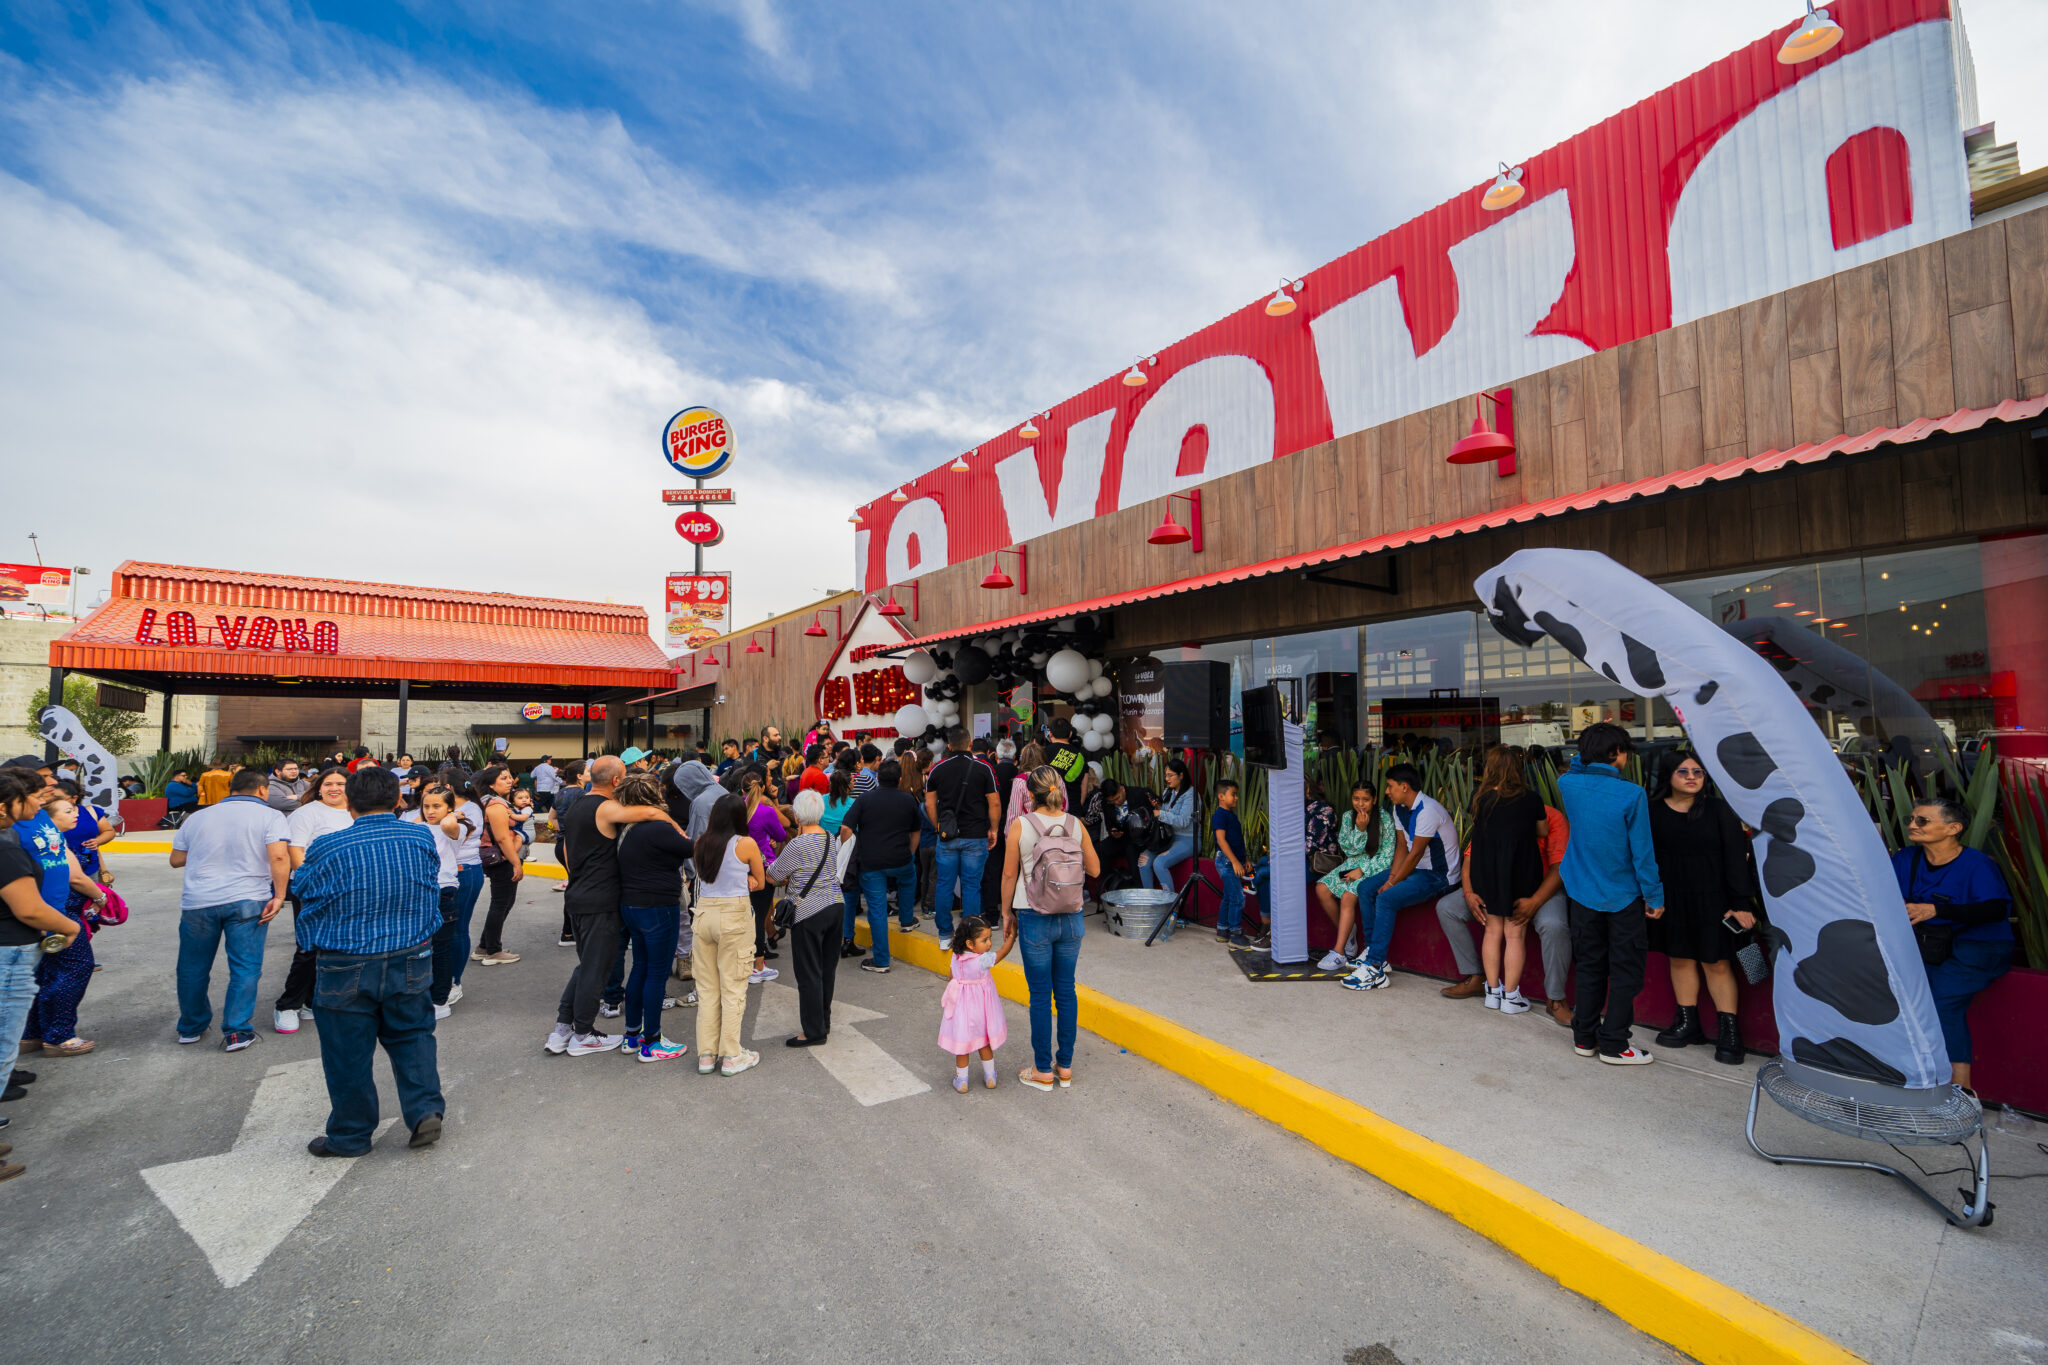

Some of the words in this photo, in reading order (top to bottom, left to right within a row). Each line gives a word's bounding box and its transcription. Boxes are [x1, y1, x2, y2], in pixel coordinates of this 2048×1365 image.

[995, 21, 1970, 547] VAKA
[670, 418, 724, 445] BURGER
[673, 430, 727, 462] KING
[680, 520, 712, 536] vips
[674, 586, 692, 596] Rey
[135, 608, 198, 648] LA
[215, 615, 339, 655] VAKA
[524, 705, 542, 713] BURGER
[525, 709, 543, 717] KING
